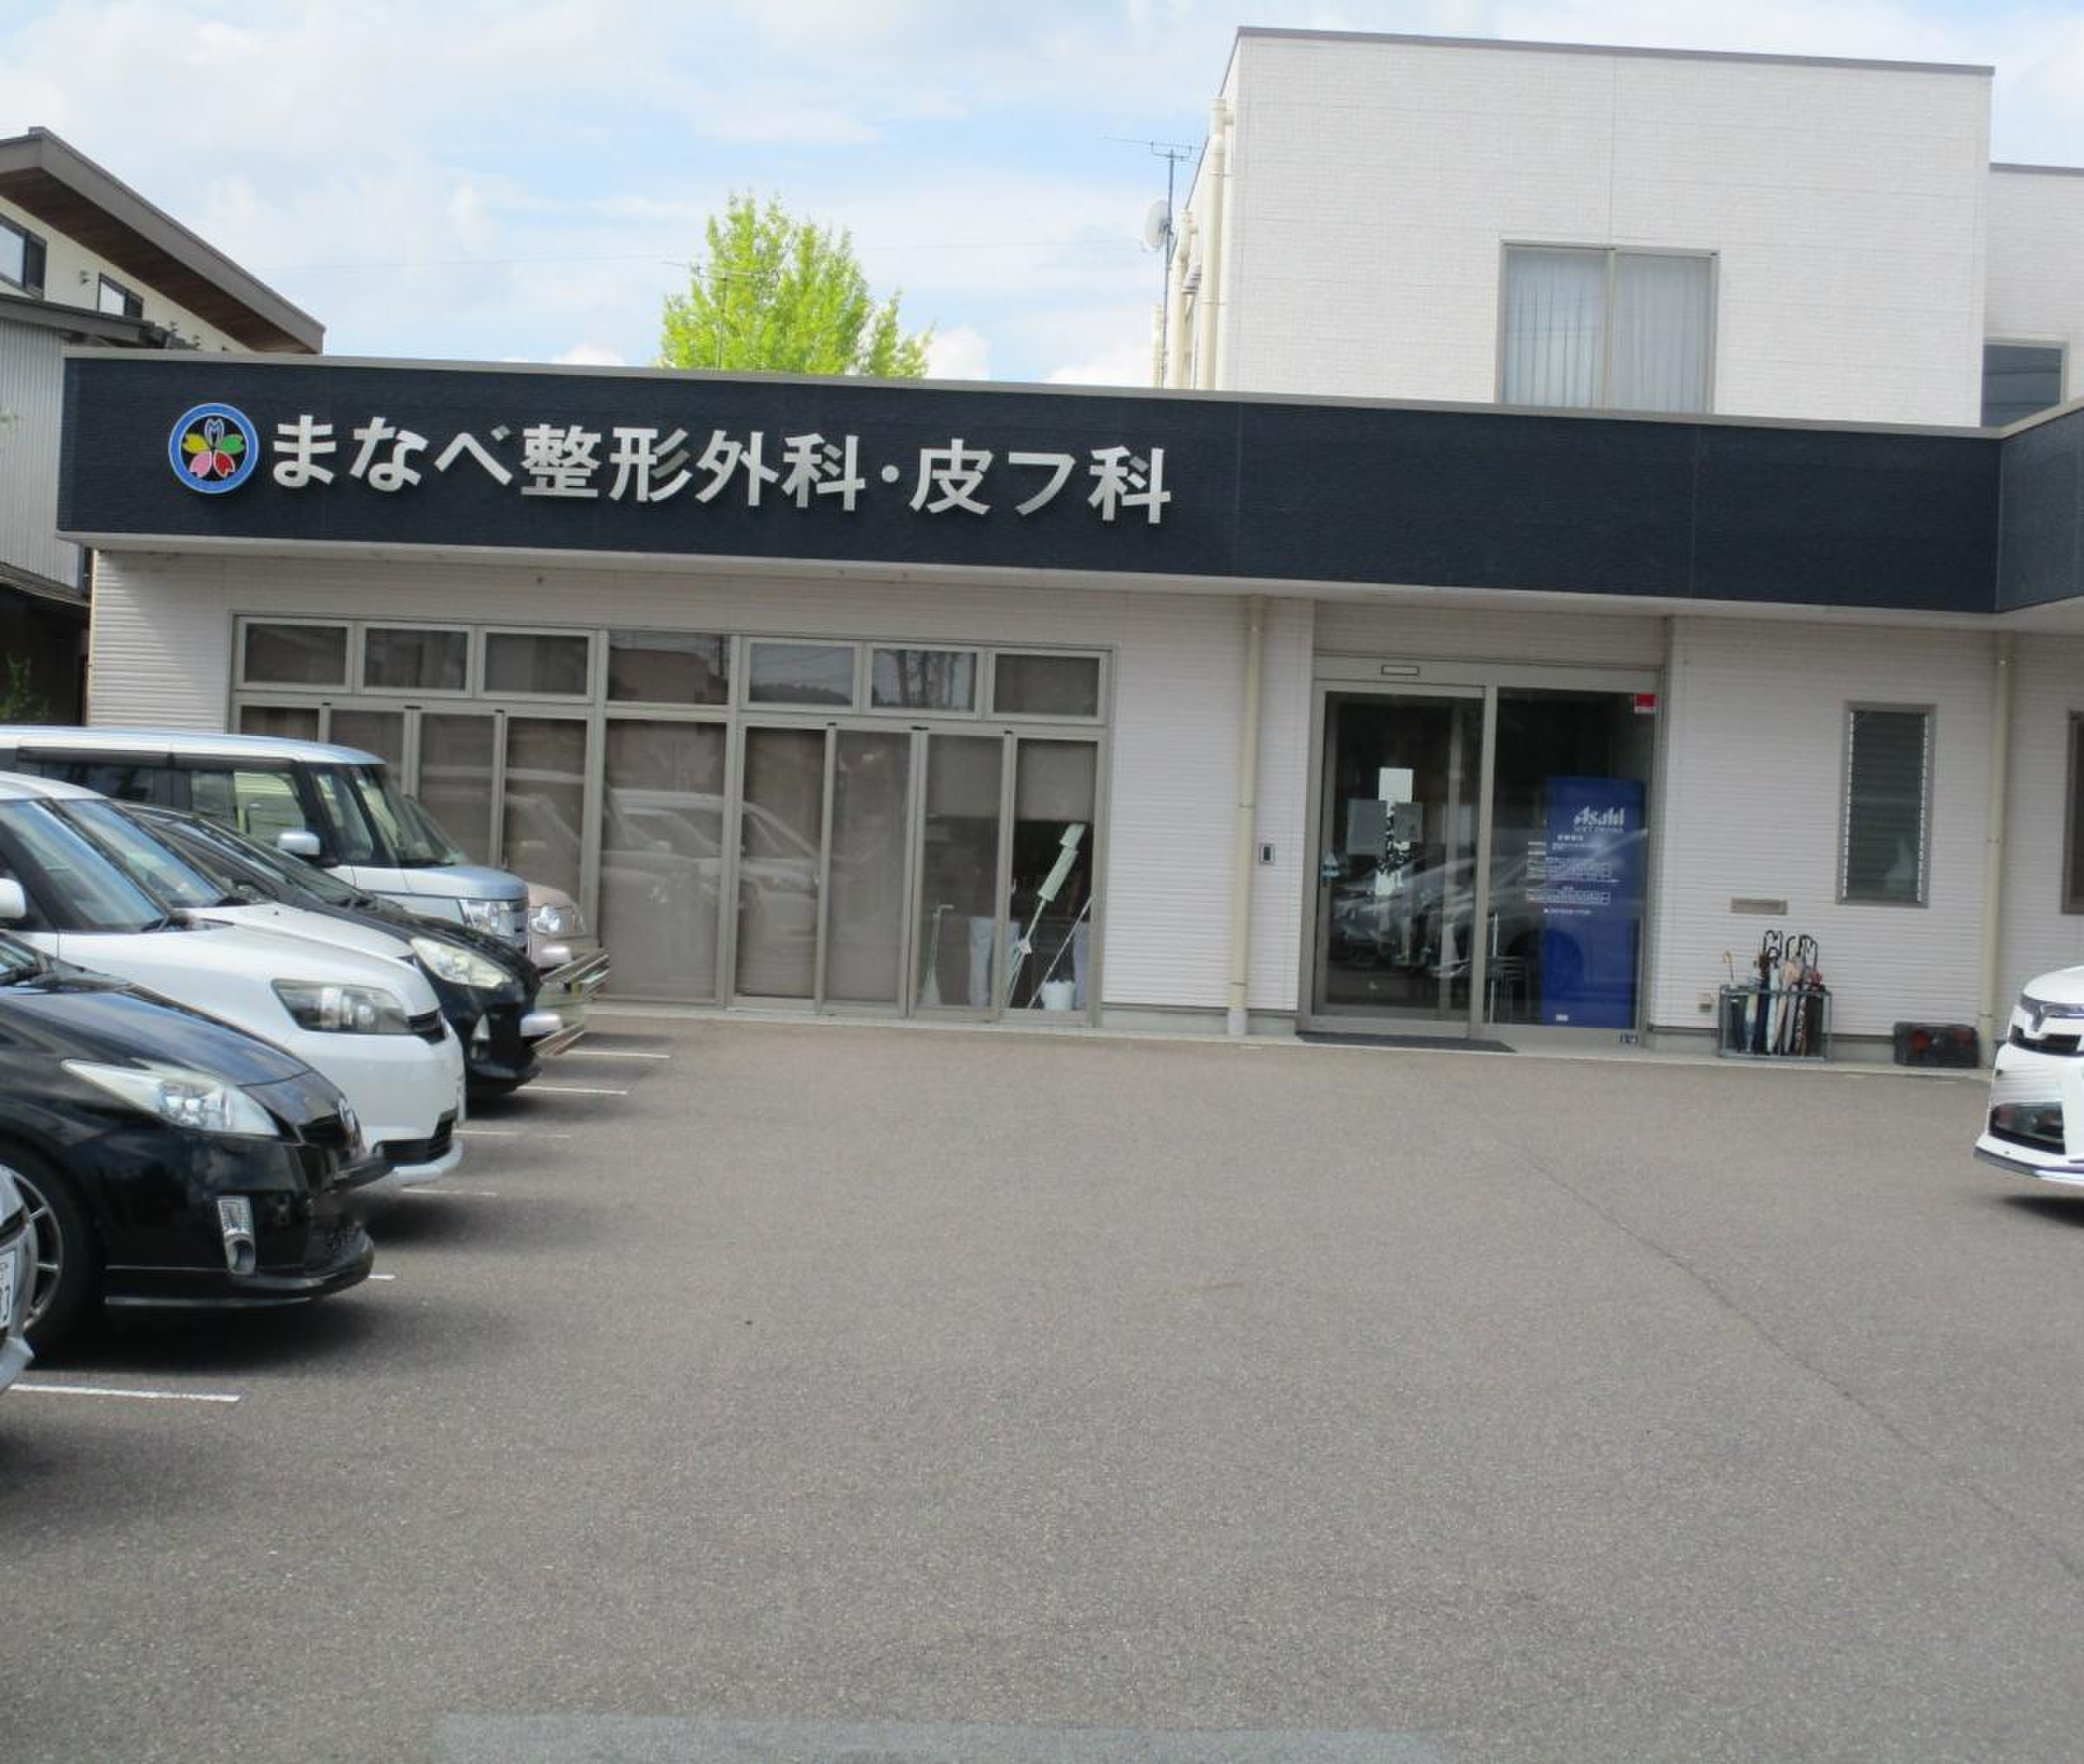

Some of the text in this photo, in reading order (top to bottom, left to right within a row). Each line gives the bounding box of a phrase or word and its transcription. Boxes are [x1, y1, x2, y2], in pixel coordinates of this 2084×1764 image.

[272, 414, 1171, 524] まなべ整形外科・皮フ科
